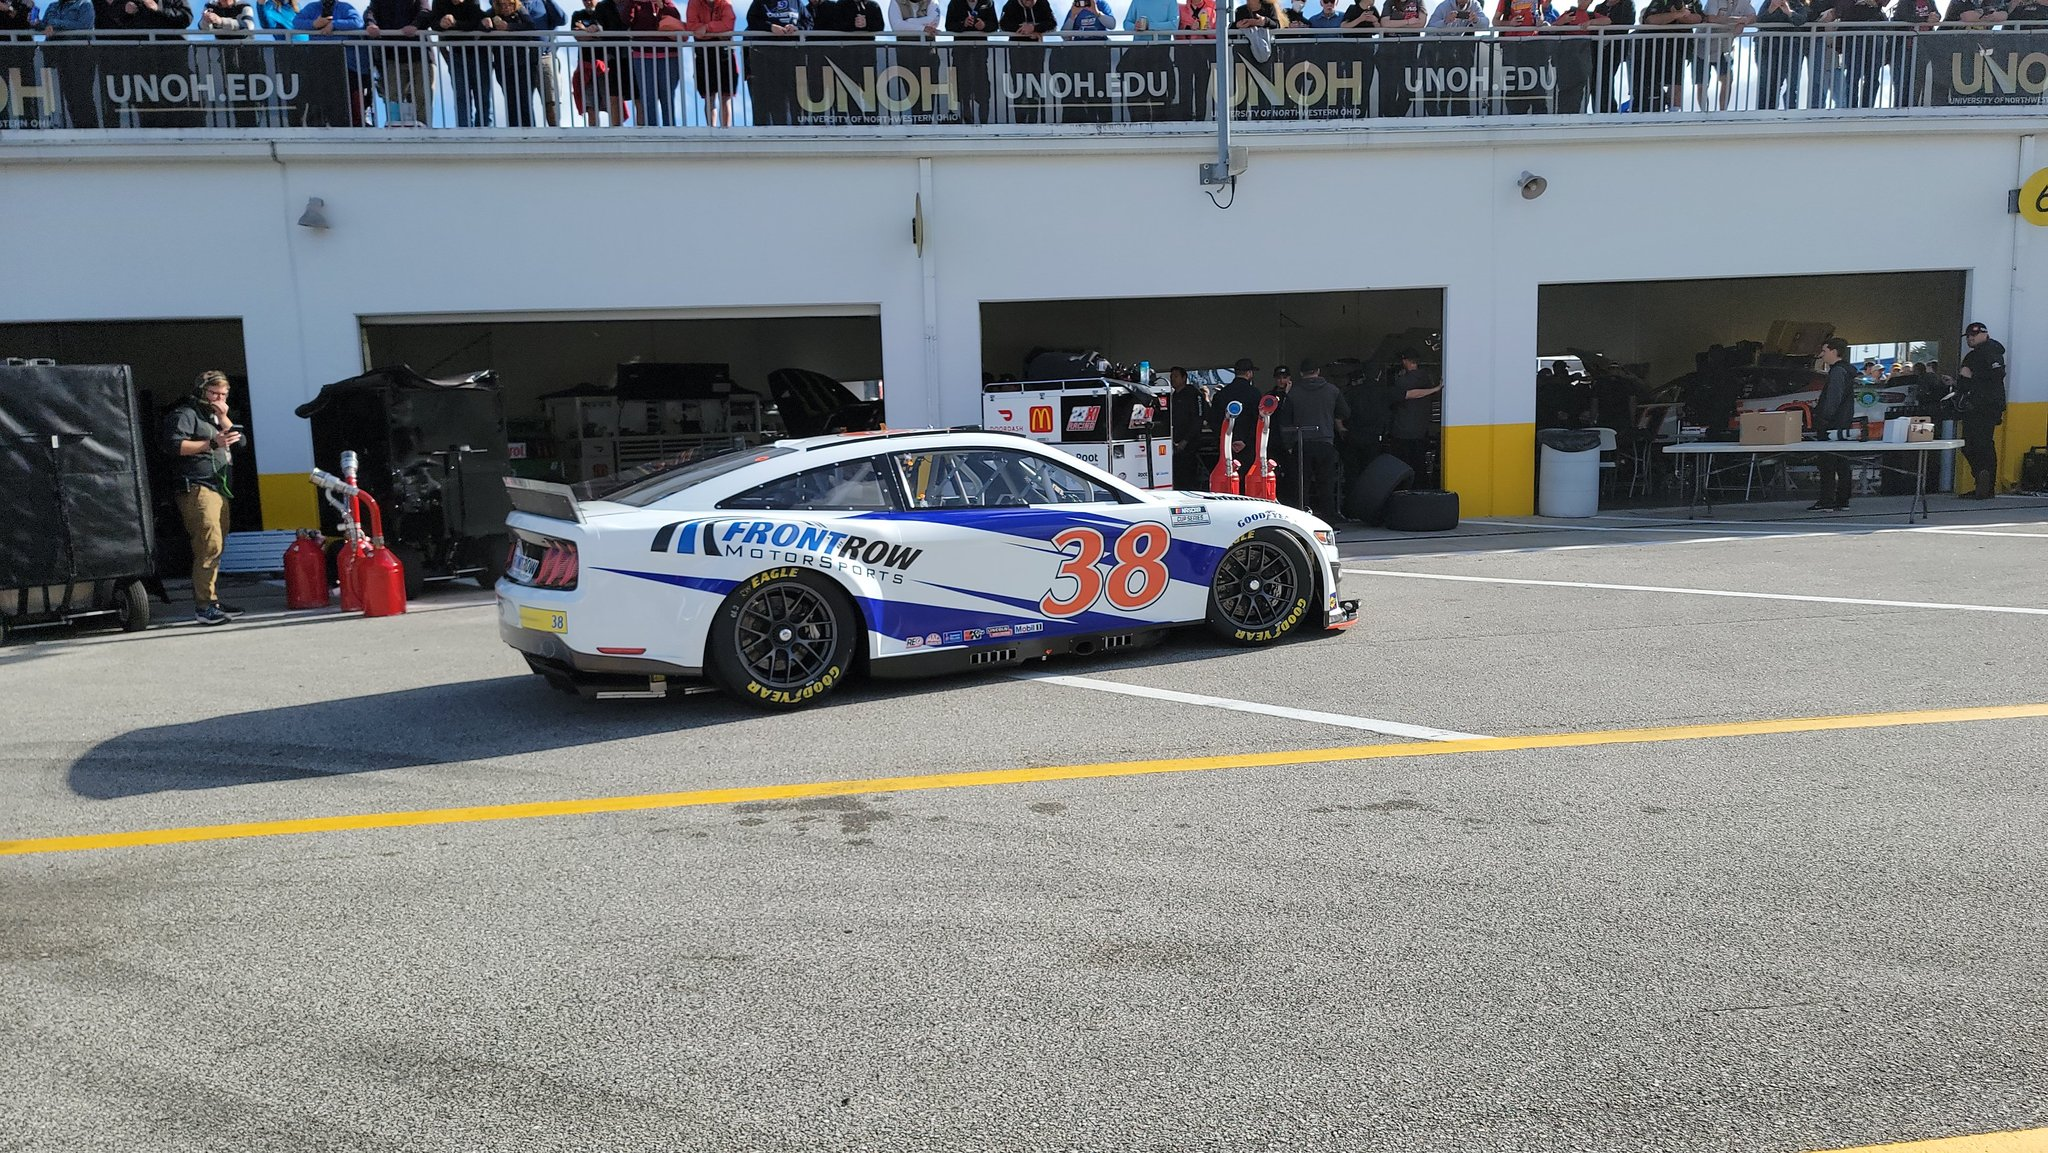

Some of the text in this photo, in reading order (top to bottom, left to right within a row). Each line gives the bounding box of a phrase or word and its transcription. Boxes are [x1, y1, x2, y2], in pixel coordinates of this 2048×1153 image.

[0, 67, 55, 116] H
[106, 74, 299, 102] UNOH.EDU
[795, 56, 958, 113] UNOH
[1002, 71, 1168, 98] UNOH.EDU
[1211, 52, 1362, 106] UNOH
[1404, 66, 1557, 92] UNOH.EDU
[1211, 108, 1361, 118] UERSITY OF NORTHWESTERN OHIO
[1950, 97, 1994, 105] UNIVERSITY
[797, 115, 850, 123] UNIVERSITY
[851, 115, 862, 123] OF
[863, 114, 933, 123] NORTHWESTERN
[725, 545, 904, 584] MOTORSPORTS
[751, 567, 799, 588] EAGLE
[1039, 520, 1171, 619] 38
[551, 615, 564, 629] 38
[1235, 598, 1306, 641] GOODYEAR
[746, 665, 840, 703] GOODYEAR
